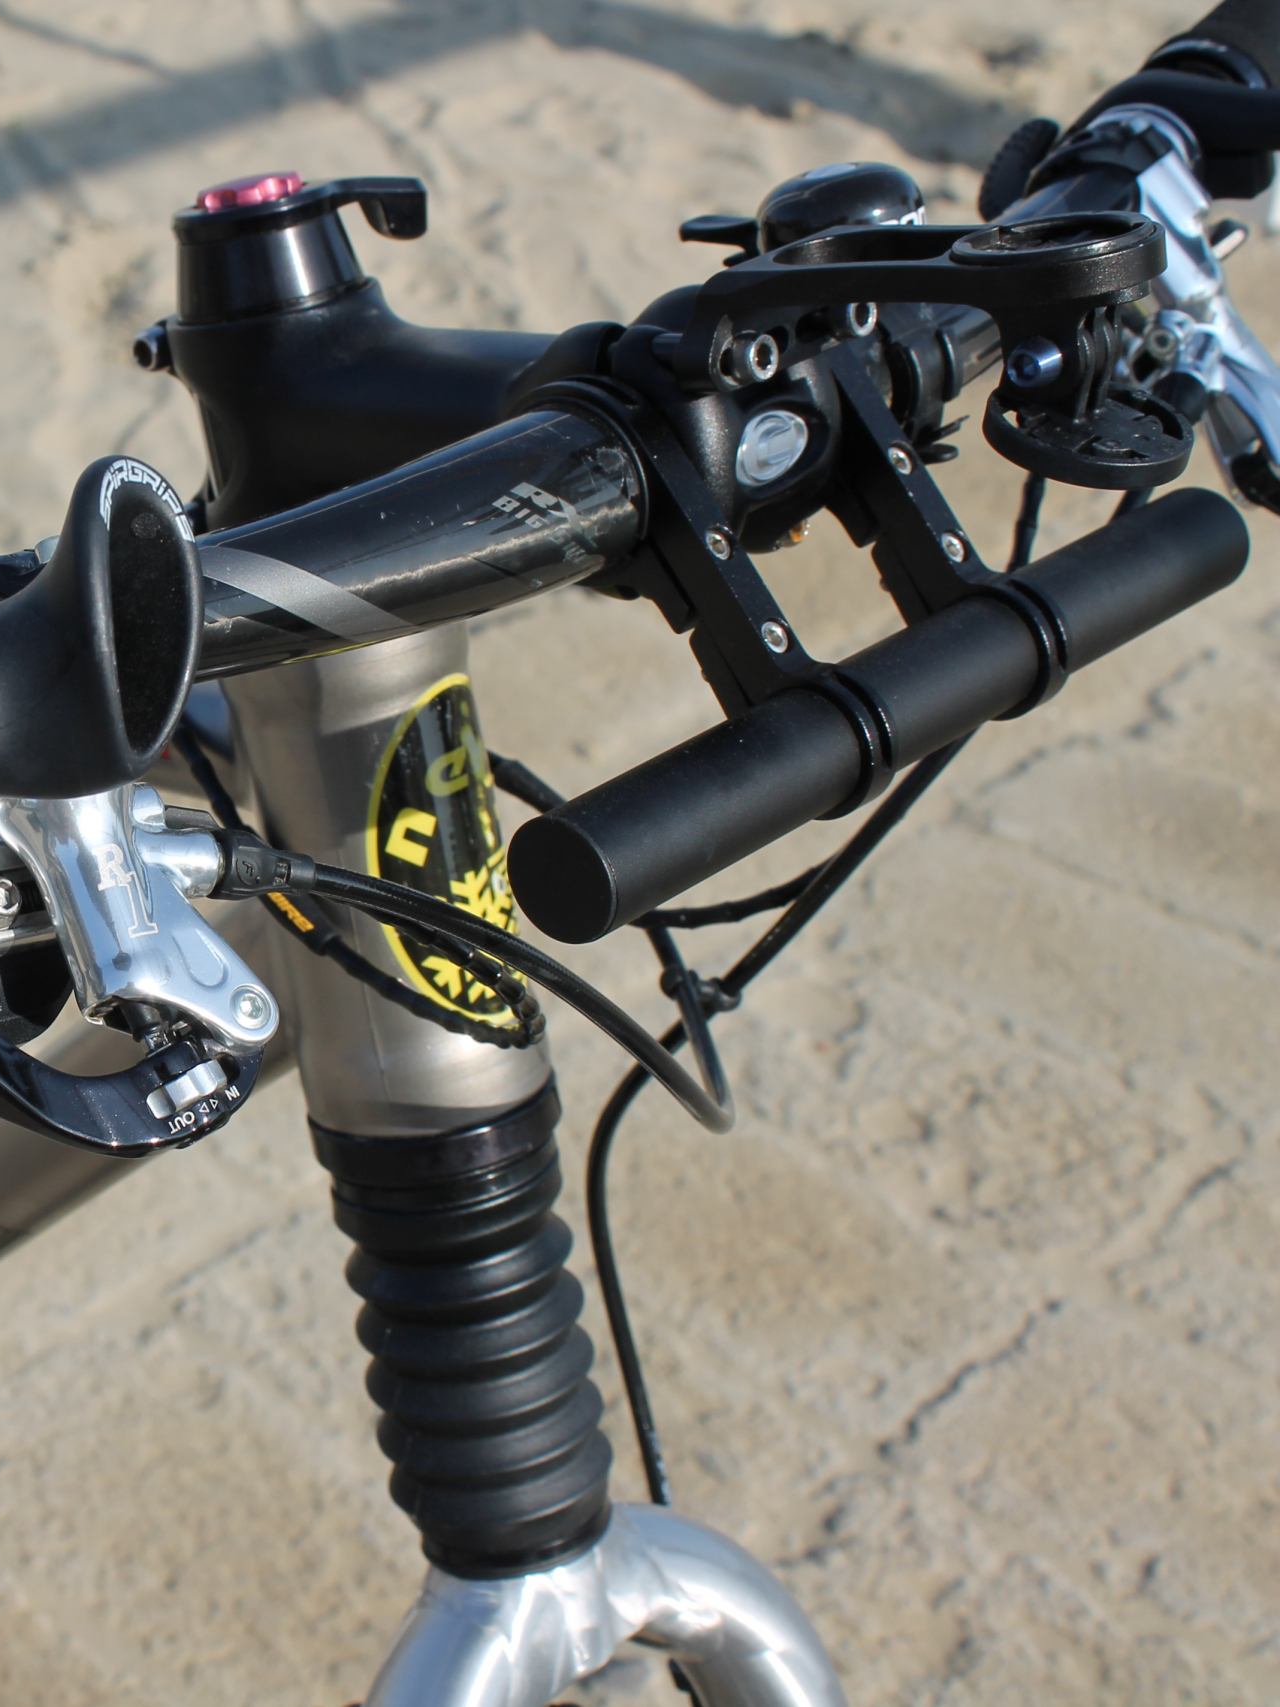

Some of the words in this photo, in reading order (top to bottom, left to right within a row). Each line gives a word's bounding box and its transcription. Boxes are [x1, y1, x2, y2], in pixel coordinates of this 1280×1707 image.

[492, 495, 550, 529] BIG
[224, 1084, 241, 1102] IN
[167, 1110, 195, 1135] OUT
